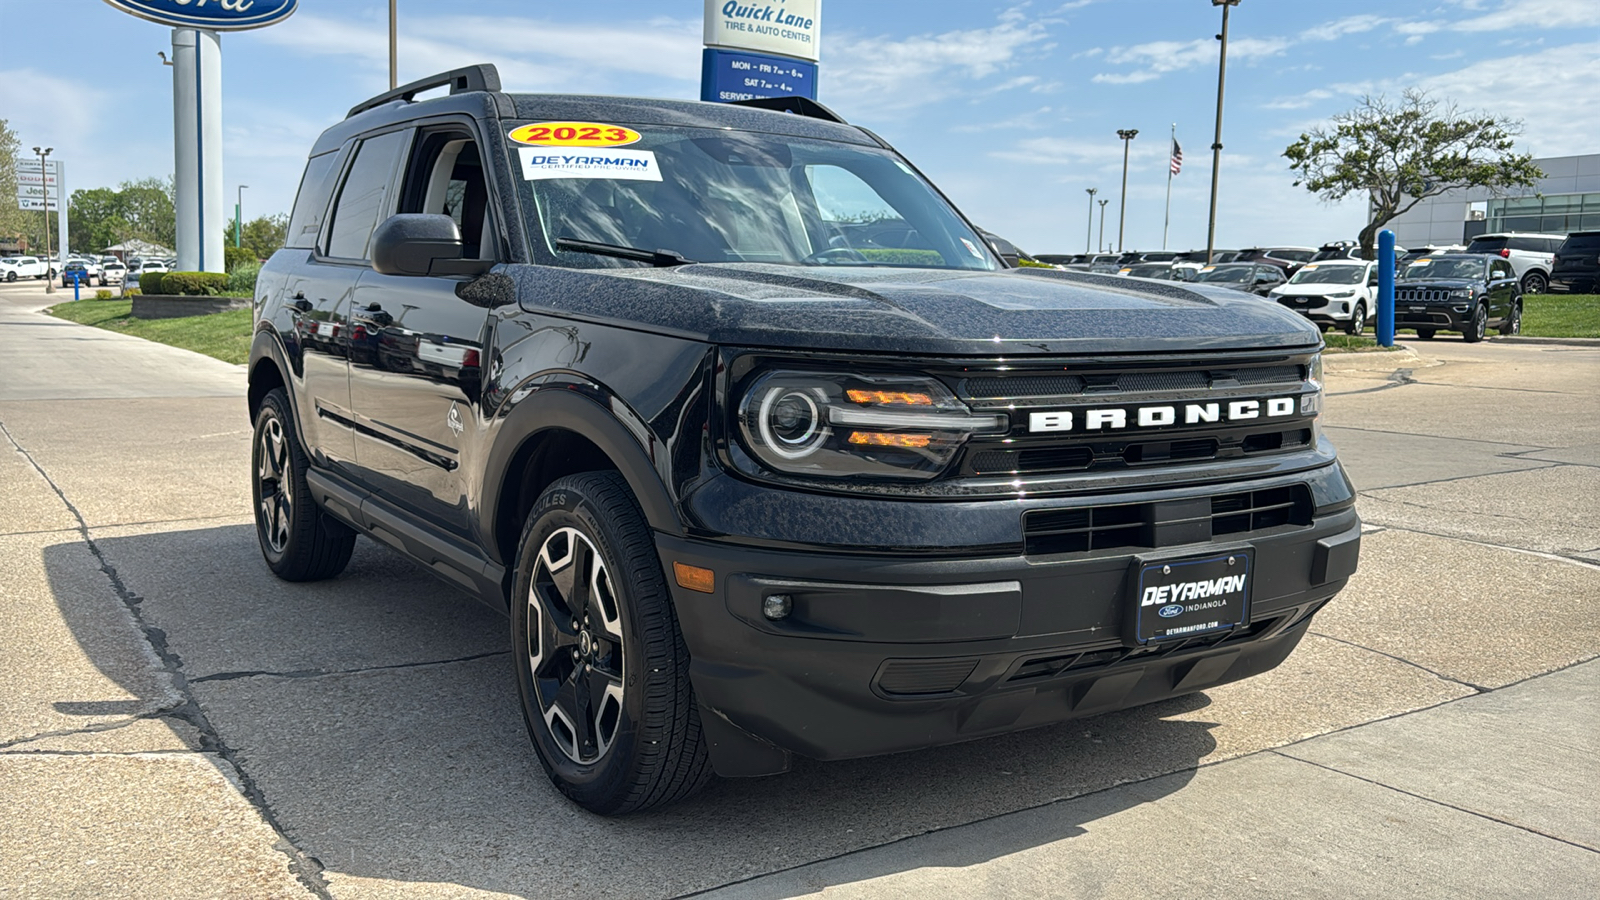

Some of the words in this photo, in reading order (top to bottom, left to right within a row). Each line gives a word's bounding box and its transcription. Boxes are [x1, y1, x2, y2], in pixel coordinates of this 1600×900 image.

[722, 0, 774, 21] Quick
[775, 9, 813, 29] Lane
[725, 20, 746, 31] TIRE
[747, 24, 754, 32] &
[755, 25, 780, 36] AUTO
[781, 29, 811, 43] CENTER
[732, 61, 750, 70] MON
[760, 64, 771, 73] FRI
[744, 78, 759, 87] SAT
[719, 91, 753, 100] SERVICE
[526, 127, 628, 141] 2023
[531, 155, 648, 167] DEYARMAN
[594, 164, 648, 172] PRE-OWNED
[1028, 397, 1295, 433] BRONCO
[1141, 574, 1246, 607] DEYARMAN
[1161, 605, 1181, 616] Ford
[1185, 599, 1227, 612] INDIANOLA
[1166, 621, 1218, 635] DEYARMANFORD.COM
